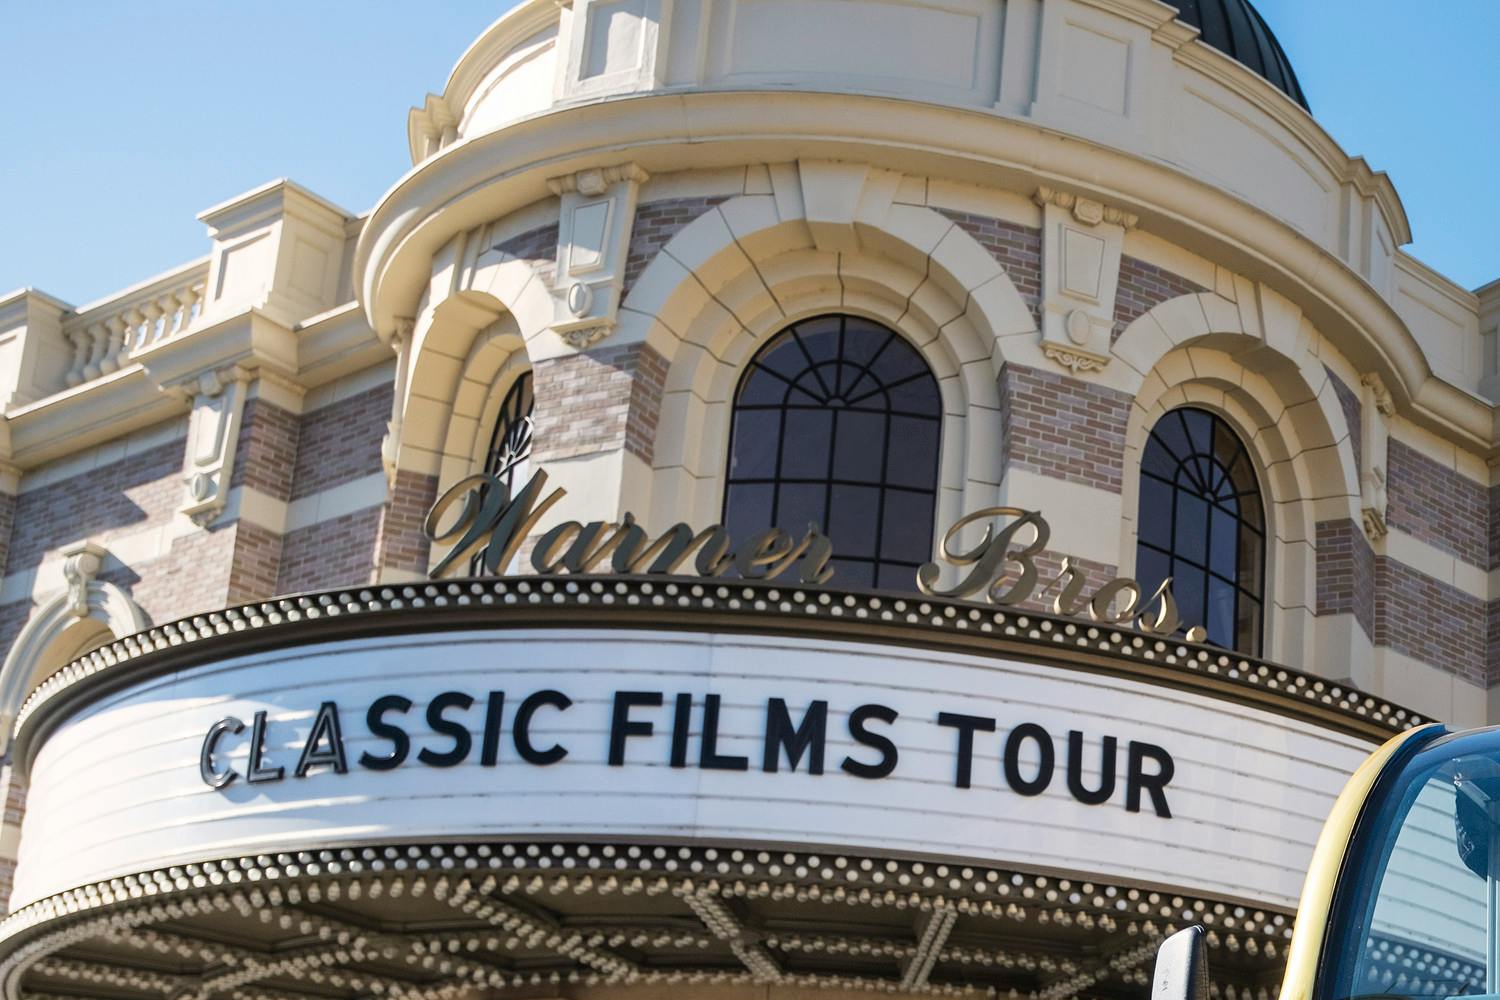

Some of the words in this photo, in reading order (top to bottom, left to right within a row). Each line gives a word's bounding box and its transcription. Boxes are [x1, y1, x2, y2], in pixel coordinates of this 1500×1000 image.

[423, 467, 835, 585] Warner
[916, 506, 1208, 643] Bros.
[200, 689, 574, 791] CLASSIC
[607, 691, 899, 780] FILMS
[938, 711, 1176, 818] TOUR
